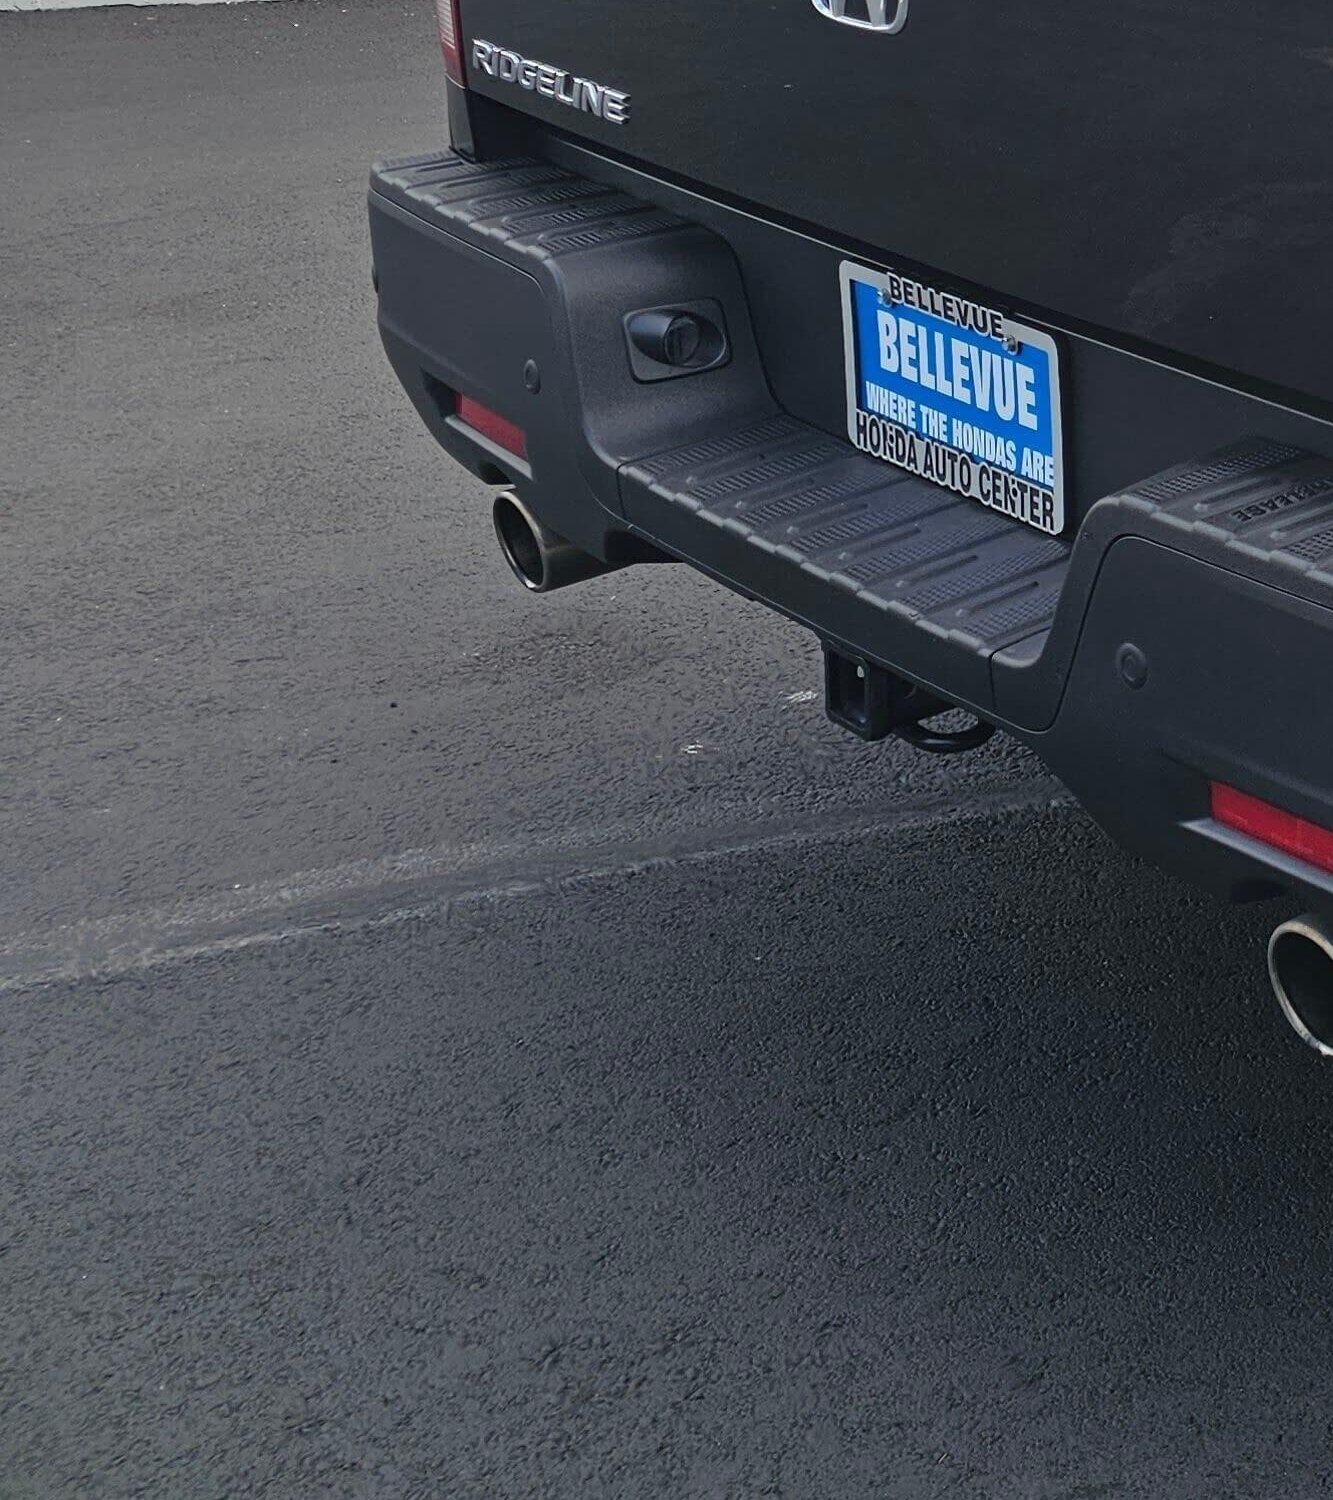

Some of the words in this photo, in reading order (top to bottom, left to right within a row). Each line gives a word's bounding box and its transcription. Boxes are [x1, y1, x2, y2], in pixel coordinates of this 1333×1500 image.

[472, 38, 632, 124] RIDGELINE
[890, 275, 1004, 340] BELLEVUE
[877, 310, 1038, 431] BELLEVUE
[856, 412, 917, 470] HONDA
[923, 440, 972, 493] AUTO
[979, 463, 1055, 531] CENTER
[865, 380, 916, 429] WHERE
[919, 404, 948, 443] THE
[952, 418, 1016, 473] HONDAS
[1021, 447, 1055, 487] ARE
